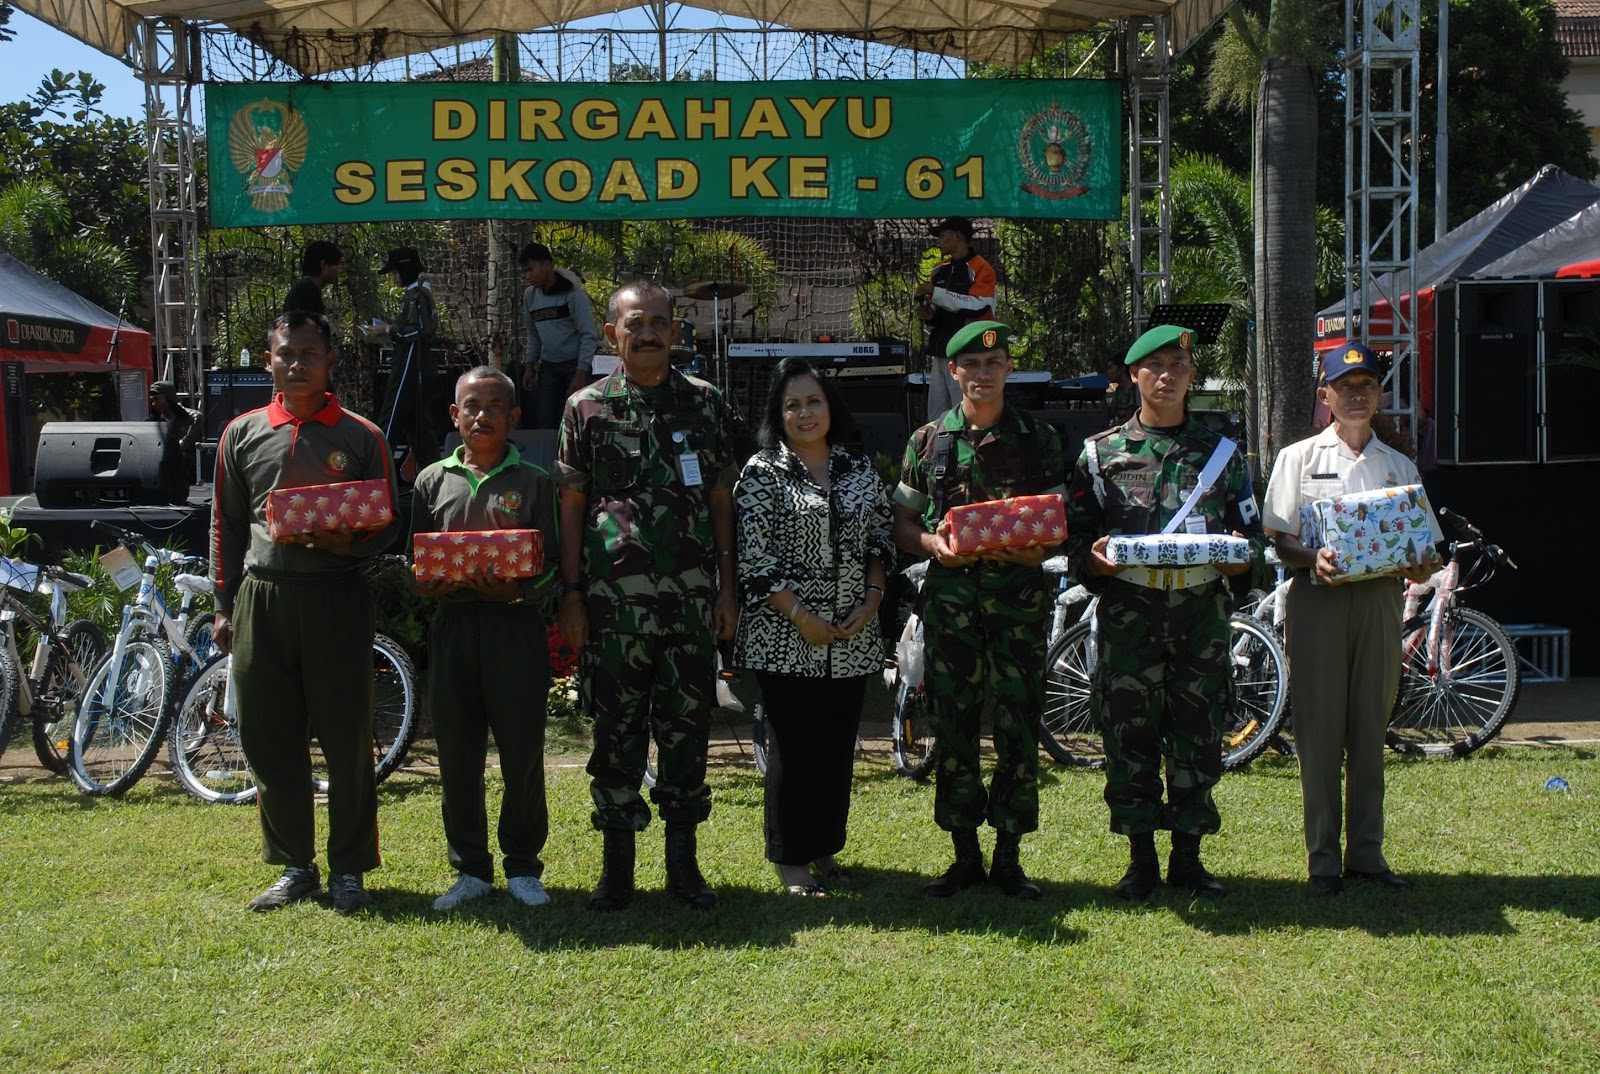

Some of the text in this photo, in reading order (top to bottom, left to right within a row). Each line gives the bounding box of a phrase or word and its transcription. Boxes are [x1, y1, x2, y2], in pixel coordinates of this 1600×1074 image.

[432, 97, 893, 142] DIRGAHAYU
[332, 157, 700, 205] SESKOAD
[729, 156, 829, 201] KE
[905, 155, 986, 201] 61
[21, 324, 75, 344] DJARUM SUPER
[852, 346, 875, 354] KORG
